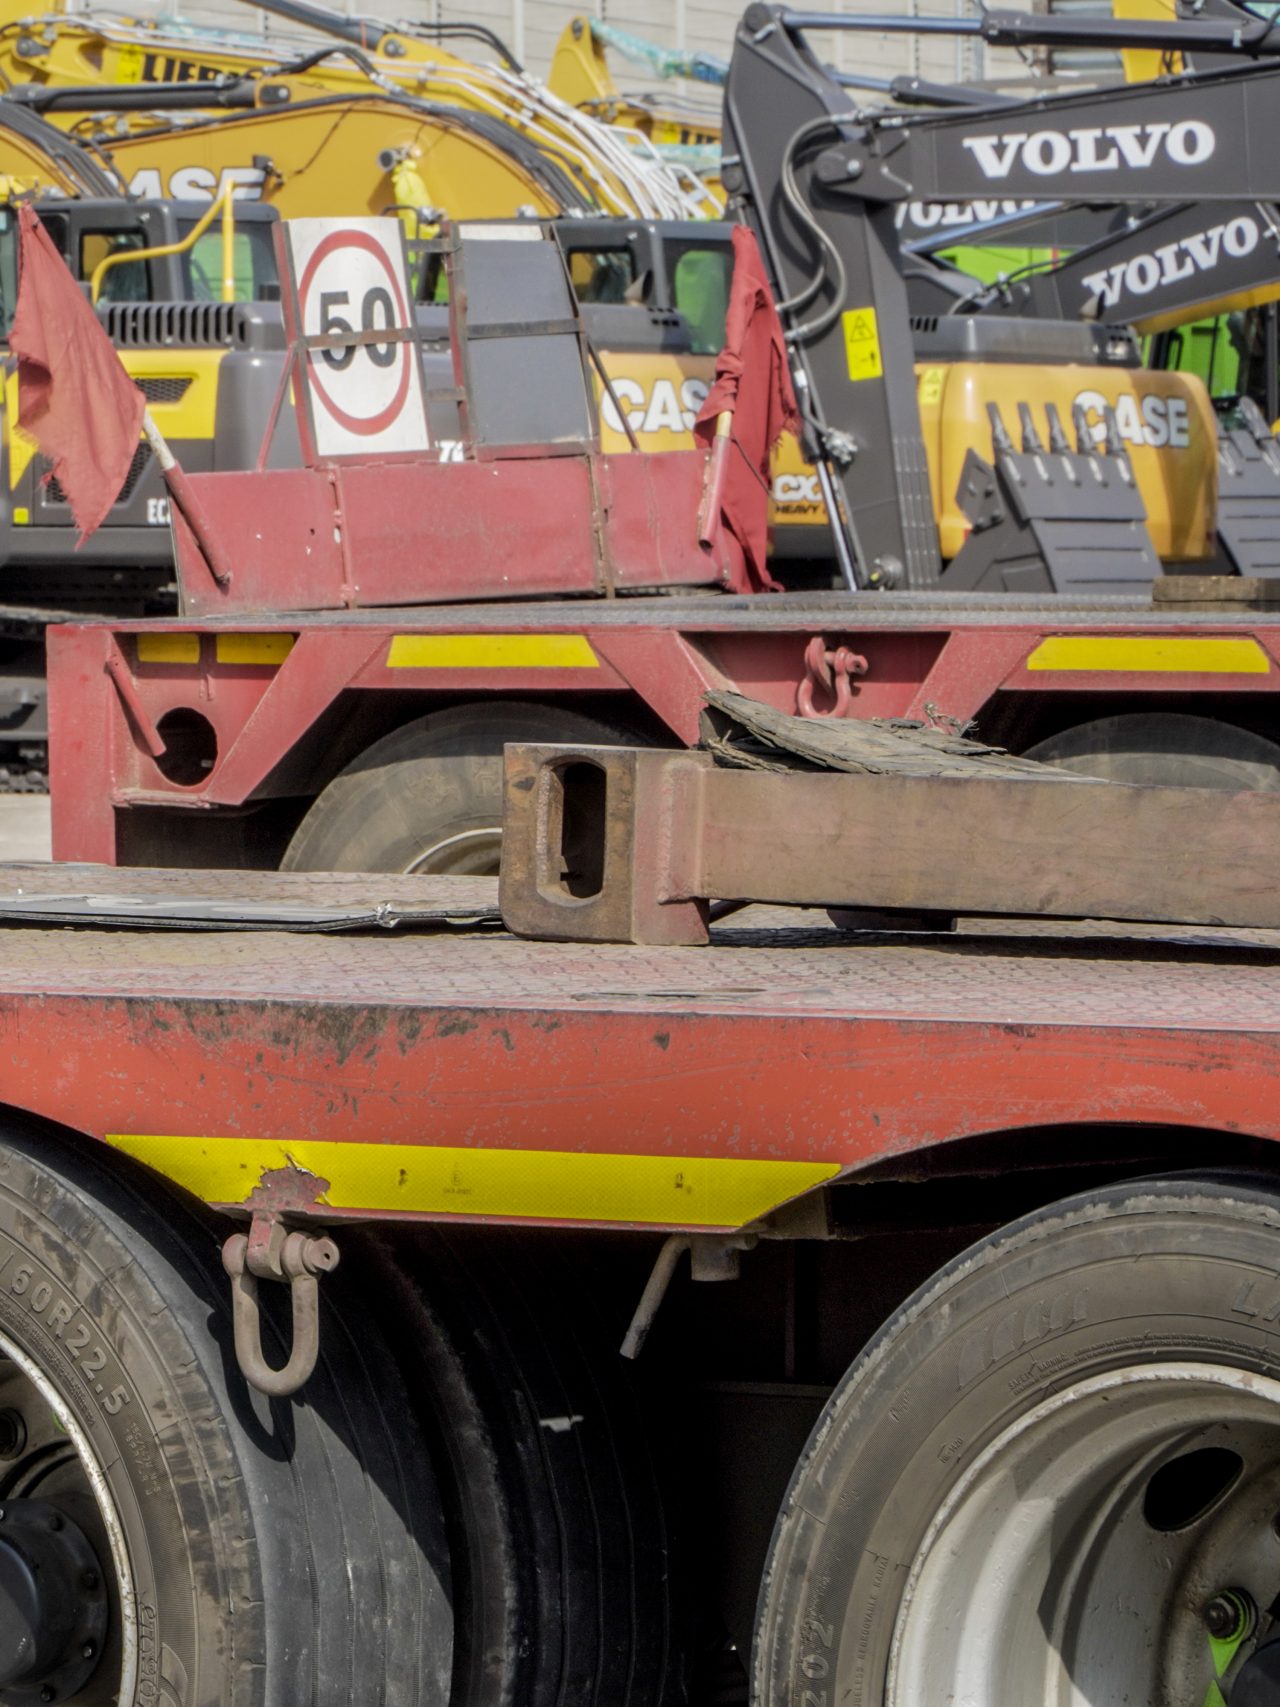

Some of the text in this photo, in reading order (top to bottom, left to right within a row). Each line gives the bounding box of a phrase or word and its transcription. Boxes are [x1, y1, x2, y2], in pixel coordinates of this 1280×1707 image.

[963, 120, 1216, 179] VOLVO
[103, 166, 268, 201] ASE
[1081, 216, 1259, 308] VOLVO
[318, 286, 397, 373] 50
[601, 378, 715, 434] CAS
[775, 505, 818, 515] HEAVY
